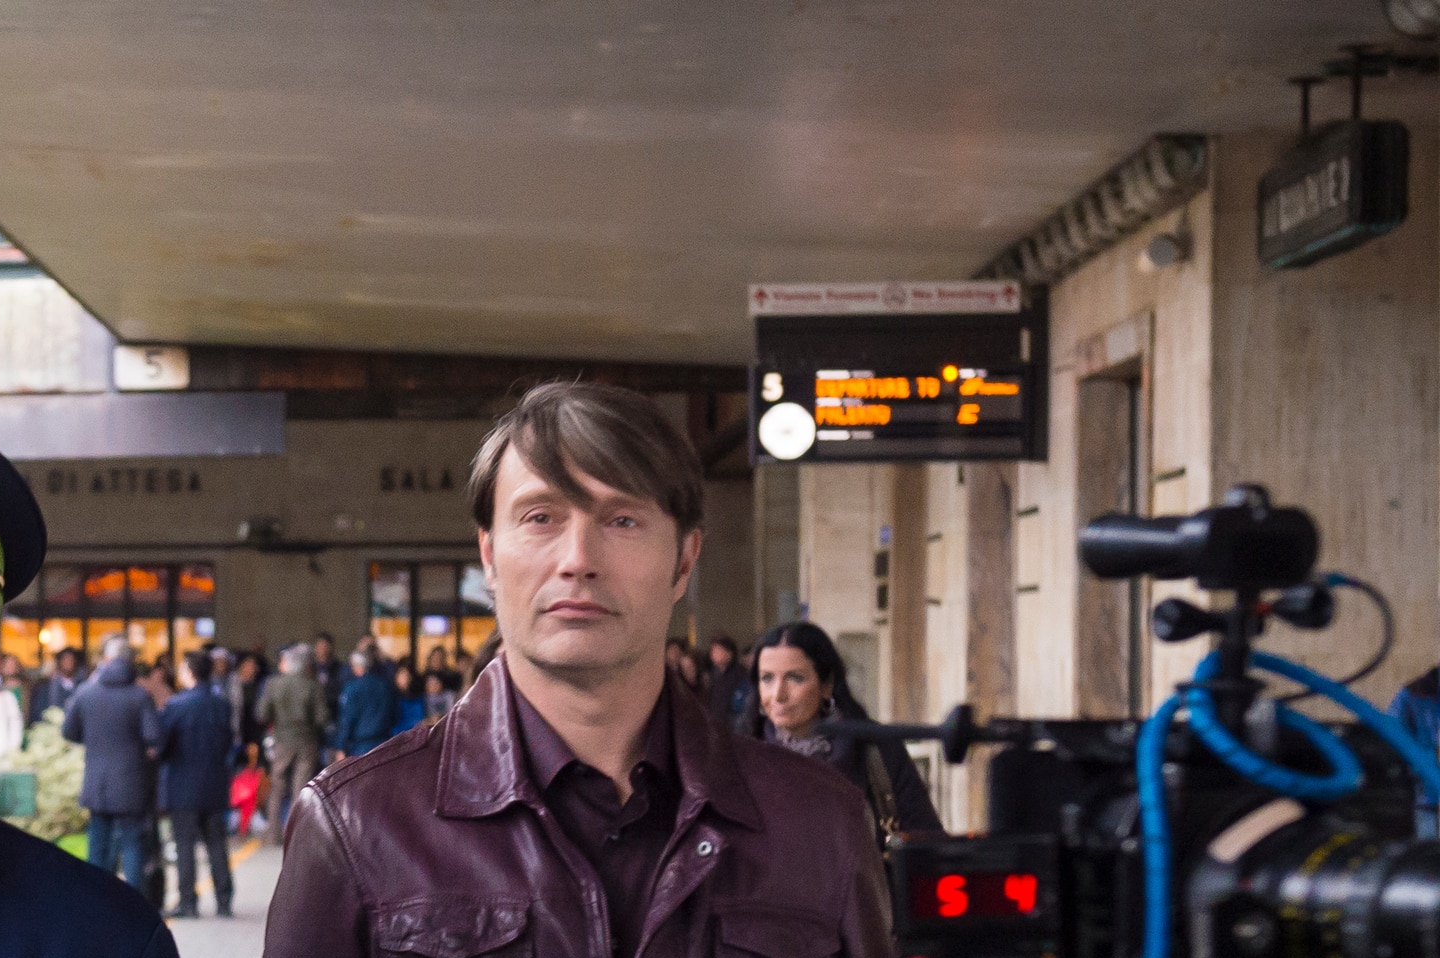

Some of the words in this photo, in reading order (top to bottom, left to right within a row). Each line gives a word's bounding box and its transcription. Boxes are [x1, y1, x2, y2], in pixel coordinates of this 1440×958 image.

[45, 468, 78, 494] DI
[89, 467, 203, 494] ATTESA
[378, 466, 455, 493] SALA
